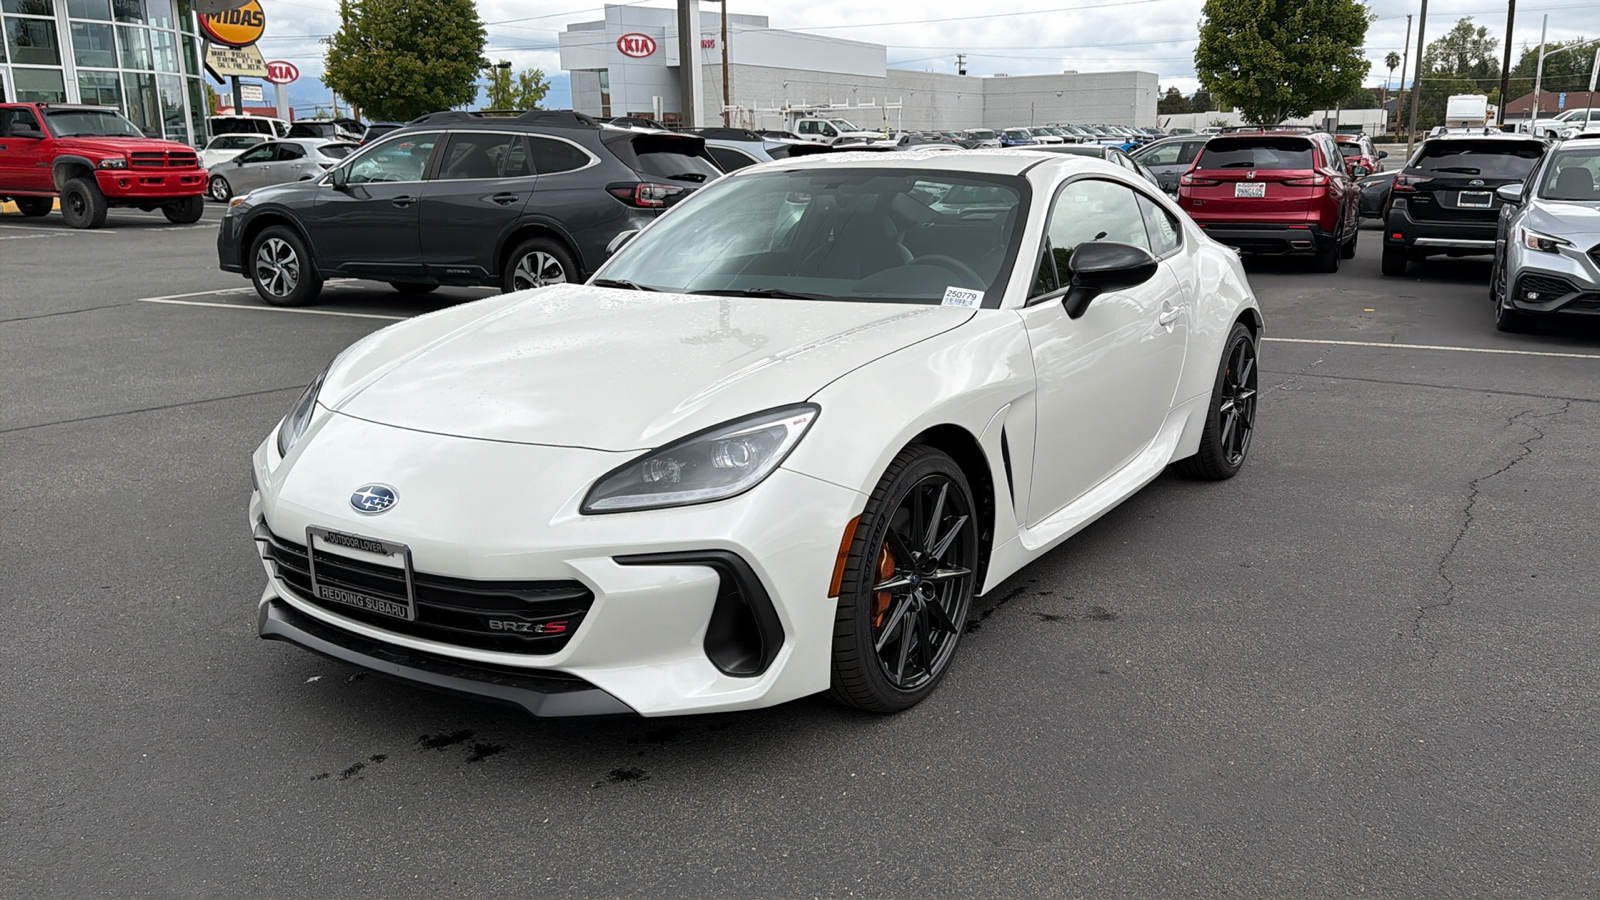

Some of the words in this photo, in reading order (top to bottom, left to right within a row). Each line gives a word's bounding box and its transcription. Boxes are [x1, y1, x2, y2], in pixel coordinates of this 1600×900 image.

[206, 9, 263, 27] MIDAS
[624, 38, 650, 53] KIA
[269, 66, 294, 79] KIA
[946, 290, 977, 301] 250779
[329, 532, 360, 548] OUTDOOR
[360, 539, 382, 553] LOVER
[322, 587, 363, 606] REDDING
[366, 598, 405, 618] SUBARU
[489, 620, 533, 632] BRZ
